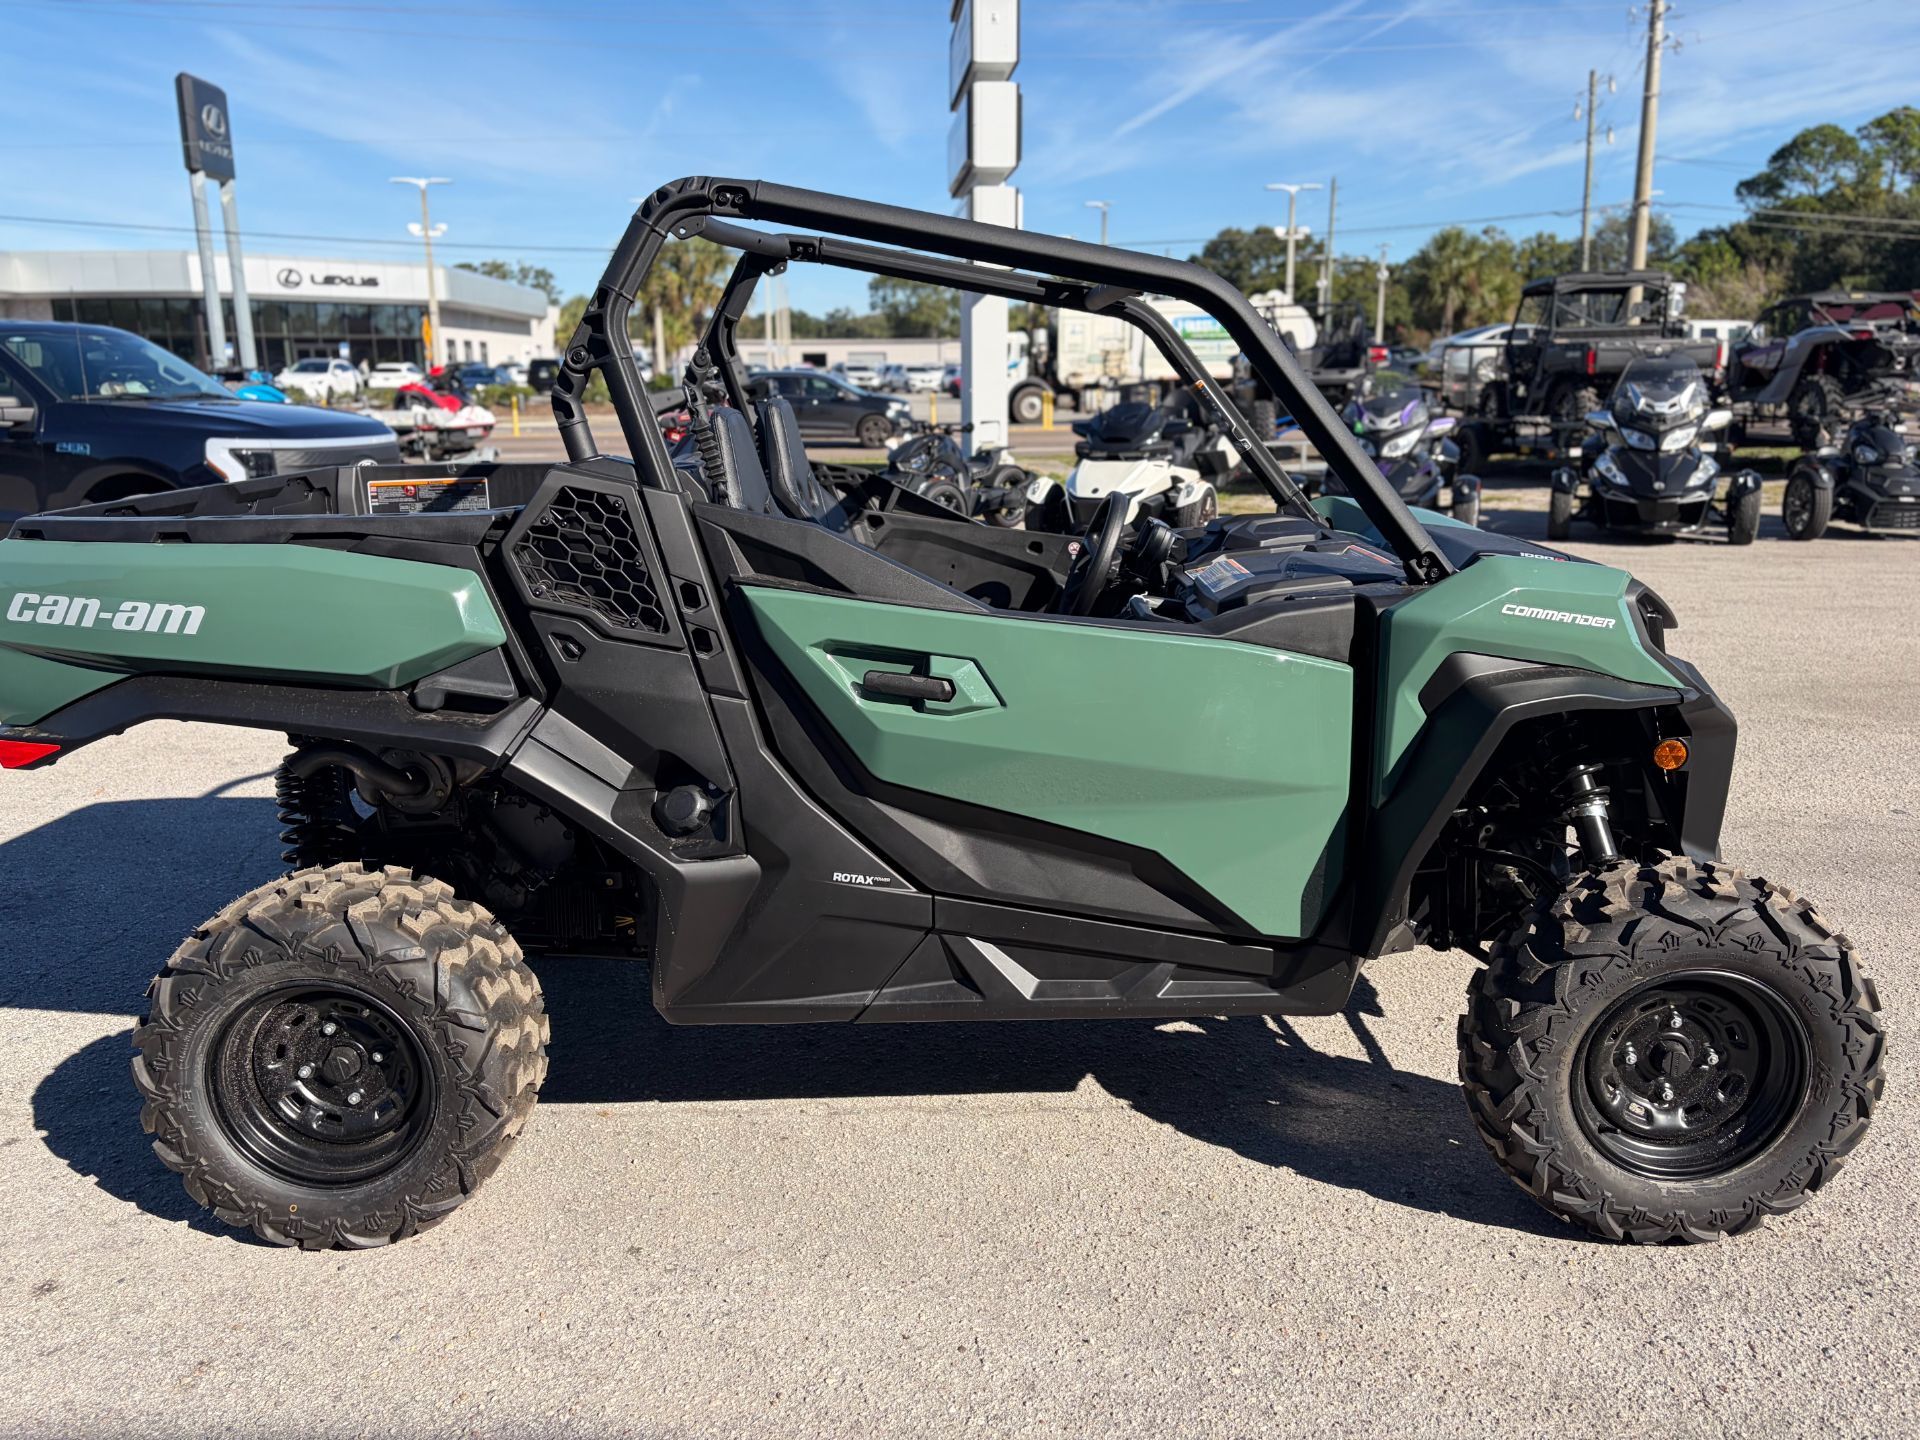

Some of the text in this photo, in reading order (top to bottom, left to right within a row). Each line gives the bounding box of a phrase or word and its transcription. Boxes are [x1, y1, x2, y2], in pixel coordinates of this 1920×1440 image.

[310, 273, 379, 287] LEXUS
[6, 592, 206, 635] can-am
[1502, 604, 1616, 628] COMMANDER
[832, 872, 874, 884] ROTAX
